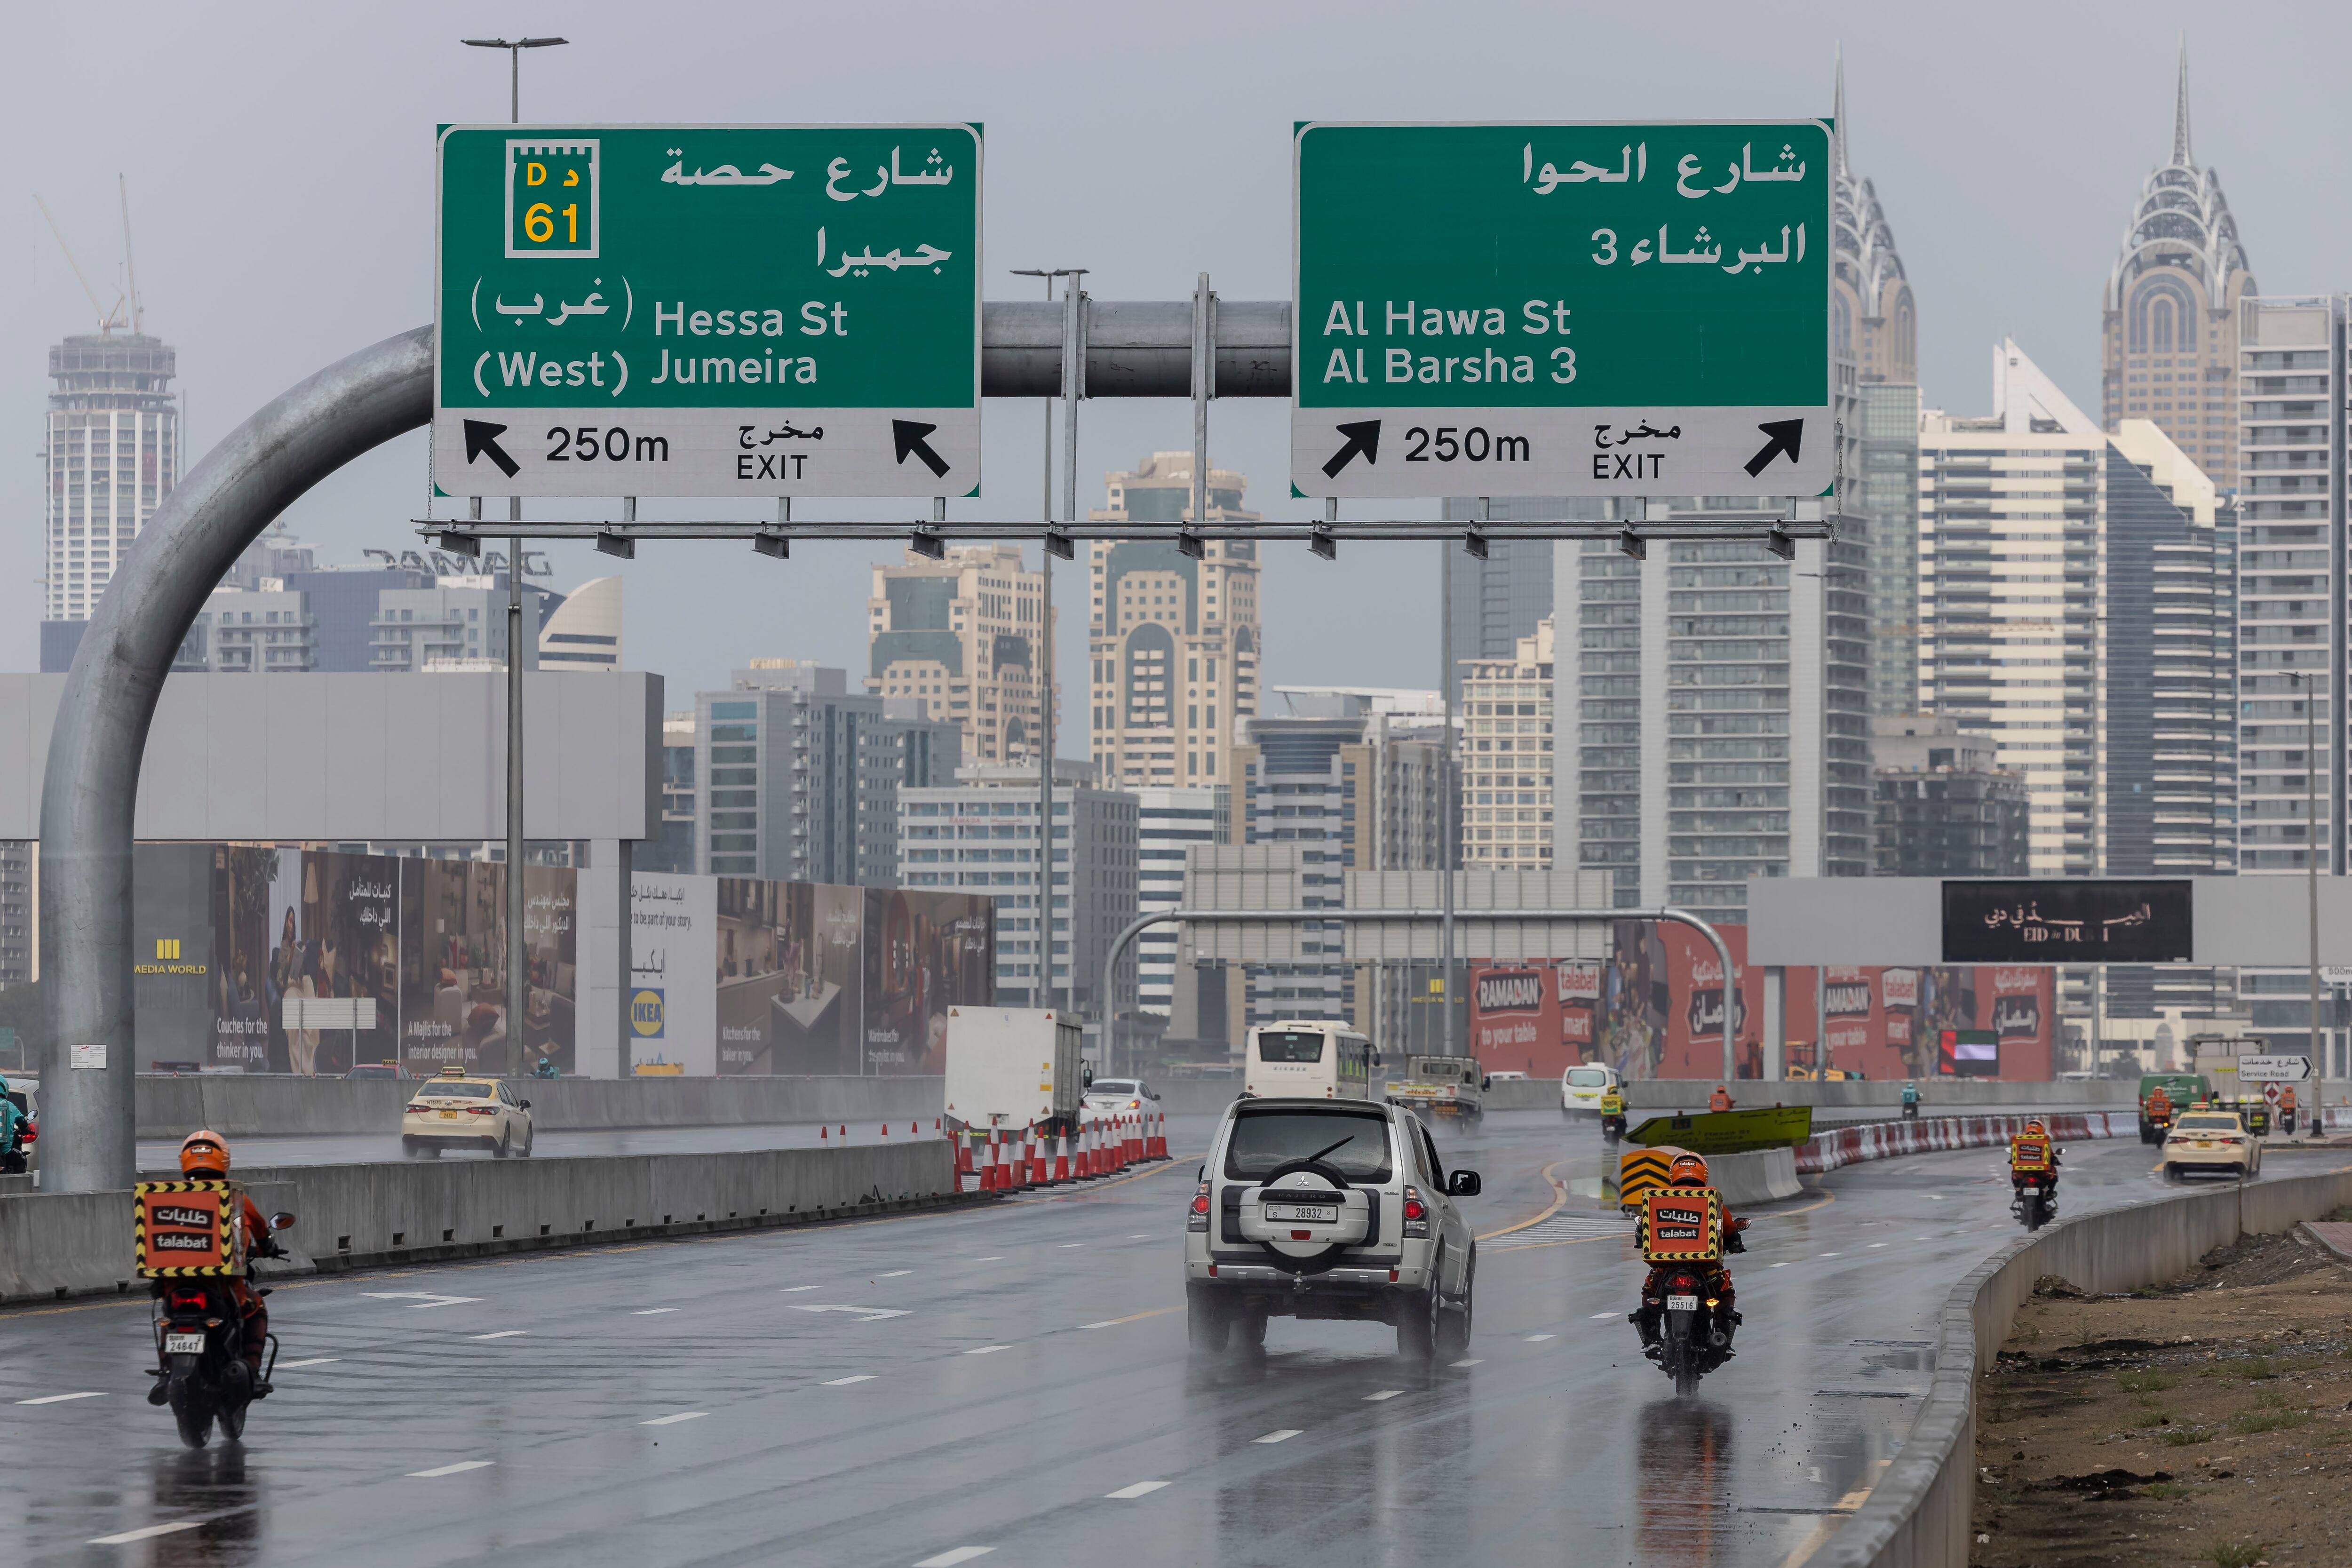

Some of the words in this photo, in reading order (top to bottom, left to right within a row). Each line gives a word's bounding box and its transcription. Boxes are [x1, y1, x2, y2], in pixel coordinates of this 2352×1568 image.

[528, 163, 546, 185] D
[564, 169, 579, 186] د
[661, 148, 795, 184] حصة
[826, 146, 952, 201] شارع
[1524, 142, 1646, 194] الحوا
[1677, 142, 1805, 198] شارع
[525, 203, 576, 242] 61
[818, 226, 952, 277] جميرا
[1592, 229, 1617, 265] 3
[1631, 223, 1805, 274] البرشاء
[656, 302, 783, 336] Hessa
[800, 302, 847, 335] St
[1324, 301, 1368, 335] Al
[1387, 301, 1505, 335] Hawa
[1522, 300, 1570, 334] St
[474, 350, 628, 397] (West)
[652, 348, 817, 383] Jumeira
[1324, 349, 1367, 382] Al
[1386, 348, 1534, 383] Barsha
[1551, 347, 1576, 383] 3
[547, 427, 668, 461] 250m
[739, 420, 823, 448] مخرج
[1406, 427, 1529, 462] 250m
[1595, 419, 1681, 448] مخرج
[738, 455, 807, 479] EXIT
[1594, 454, 1664, 478] EXIT
[634, 912, 639, 924] to
[640, 911, 646, 924] be
[648, 914, 658, 929] part
[660, 911, 665, 925] of
[665, 916, 676, 930] your
[2024, 927, 2048, 941] EID
[168, 965, 206, 974] WORLD
[1480, 978, 1538, 1007] RAMADAN
[1825, 987, 1868, 1012] AMADAN
[634, 1003, 661, 1022] IKEA
[1564, 1012, 1589, 1036] mart
[217, 1017, 244, 1034] Couches
[245, 1017, 255, 1034] for
[256, 1017, 267, 1034] the
[408, 1021, 413, 1036] A
[414, 1020, 431, 1041] Majlis
[432, 1020, 441, 1036] for
[442, 1021, 452, 1037] the
[1482, 1027, 1491, 1045] to
[1493, 1028, 1513, 1049] your
[1515, 1021, 1536, 1043] table
[1888, 1018, 1909, 1039] mart
[217, 1041, 241, 1058] thinker
[242, 1042, 248, 1058] in
[250, 1046, 263, 1063] you.
[408, 1043, 430, 1059] interior
[432, 1043, 456, 1064] designer
[458, 1043, 463, 1059] in
[2277, 1058, 2299, 1067] شارع
[157, 1208, 208, 1226] طلبات
[1295, 1208, 1322, 1218] 28932
[1660, 1210, 1699, 1223] طلبات
[156, 1235, 207, 1249] talabat
[1660, 1229, 1696, 1238] talabat
